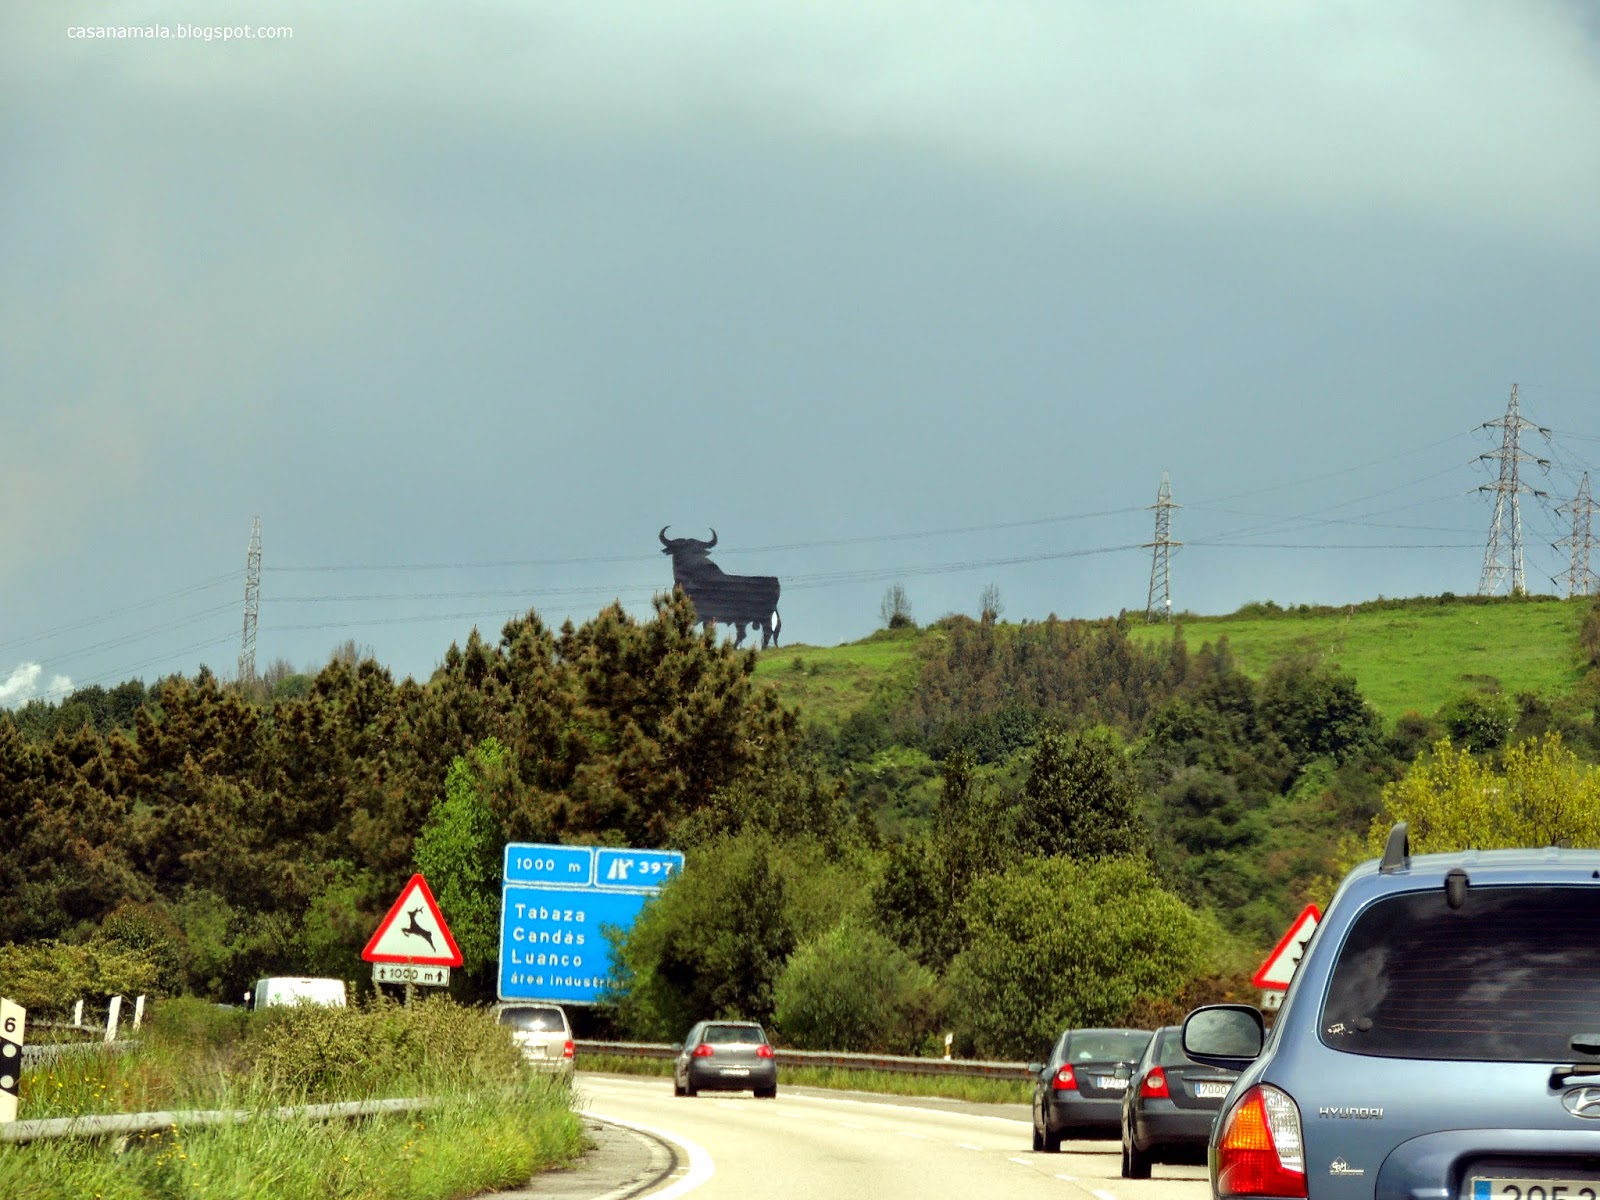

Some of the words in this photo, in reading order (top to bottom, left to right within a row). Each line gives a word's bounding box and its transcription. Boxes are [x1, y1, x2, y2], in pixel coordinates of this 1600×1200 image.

[516, 858, 555, 871] 1000
[568, 862, 581, 873] m
[638, 861, 673, 874] 397
[515, 903, 585, 922] Tabaza
[513, 927, 585, 945] Candás
[511, 949, 582, 967] Luanco
[391, 969, 418, 979] 1000
[424, 972, 433, 981] m
[4, 1017, 16, 1033] 6
[1319, 1107, 1384, 1119] HYUNDAI
